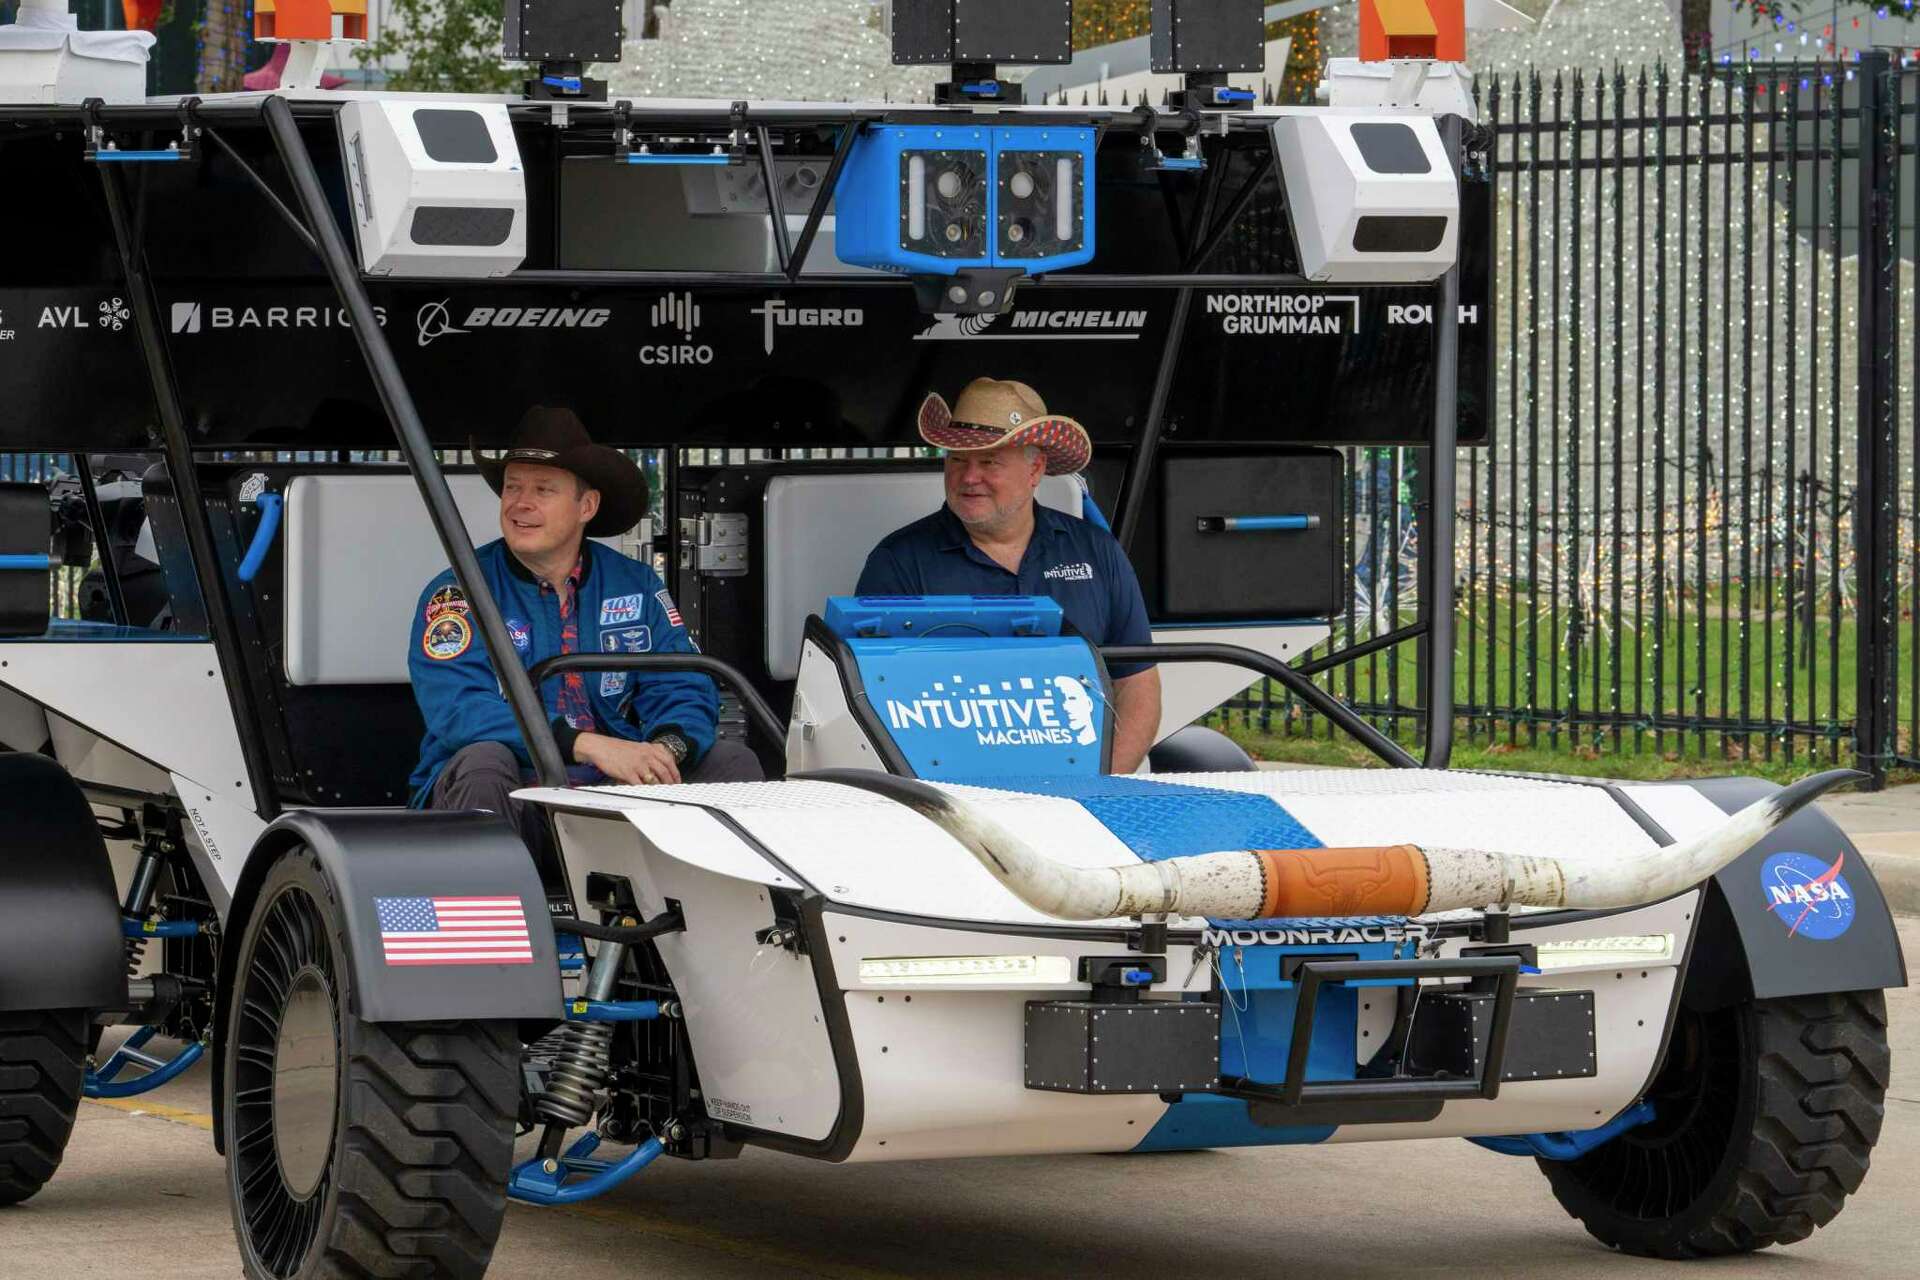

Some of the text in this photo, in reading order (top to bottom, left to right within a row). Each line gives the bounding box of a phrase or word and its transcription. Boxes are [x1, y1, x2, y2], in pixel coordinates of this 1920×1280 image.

[1206, 294, 1325, 313] NORTHROP
[38, 306, 89, 328] AVL
[463, 307, 611, 327] BOEING
[1010, 311, 1147, 328] MICHELIN
[1388, 305, 1477, 324] ROH
[1222, 315, 1340, 334] GRUMMAN
[639, 345, 713, 364] CSIRO
[1043, 568, 1085, 579] INTUITIVE
[886, 697, 1061, 729] INTUITIVE
[976, 728, 1073, 745] MACHINES
[192, 808, 205, 826] NOT
[206, 838, 221, 860] STEP
[1770, 880, 1849, 905] NASA
[1201, 925, 1429, 947] MOONRACER
